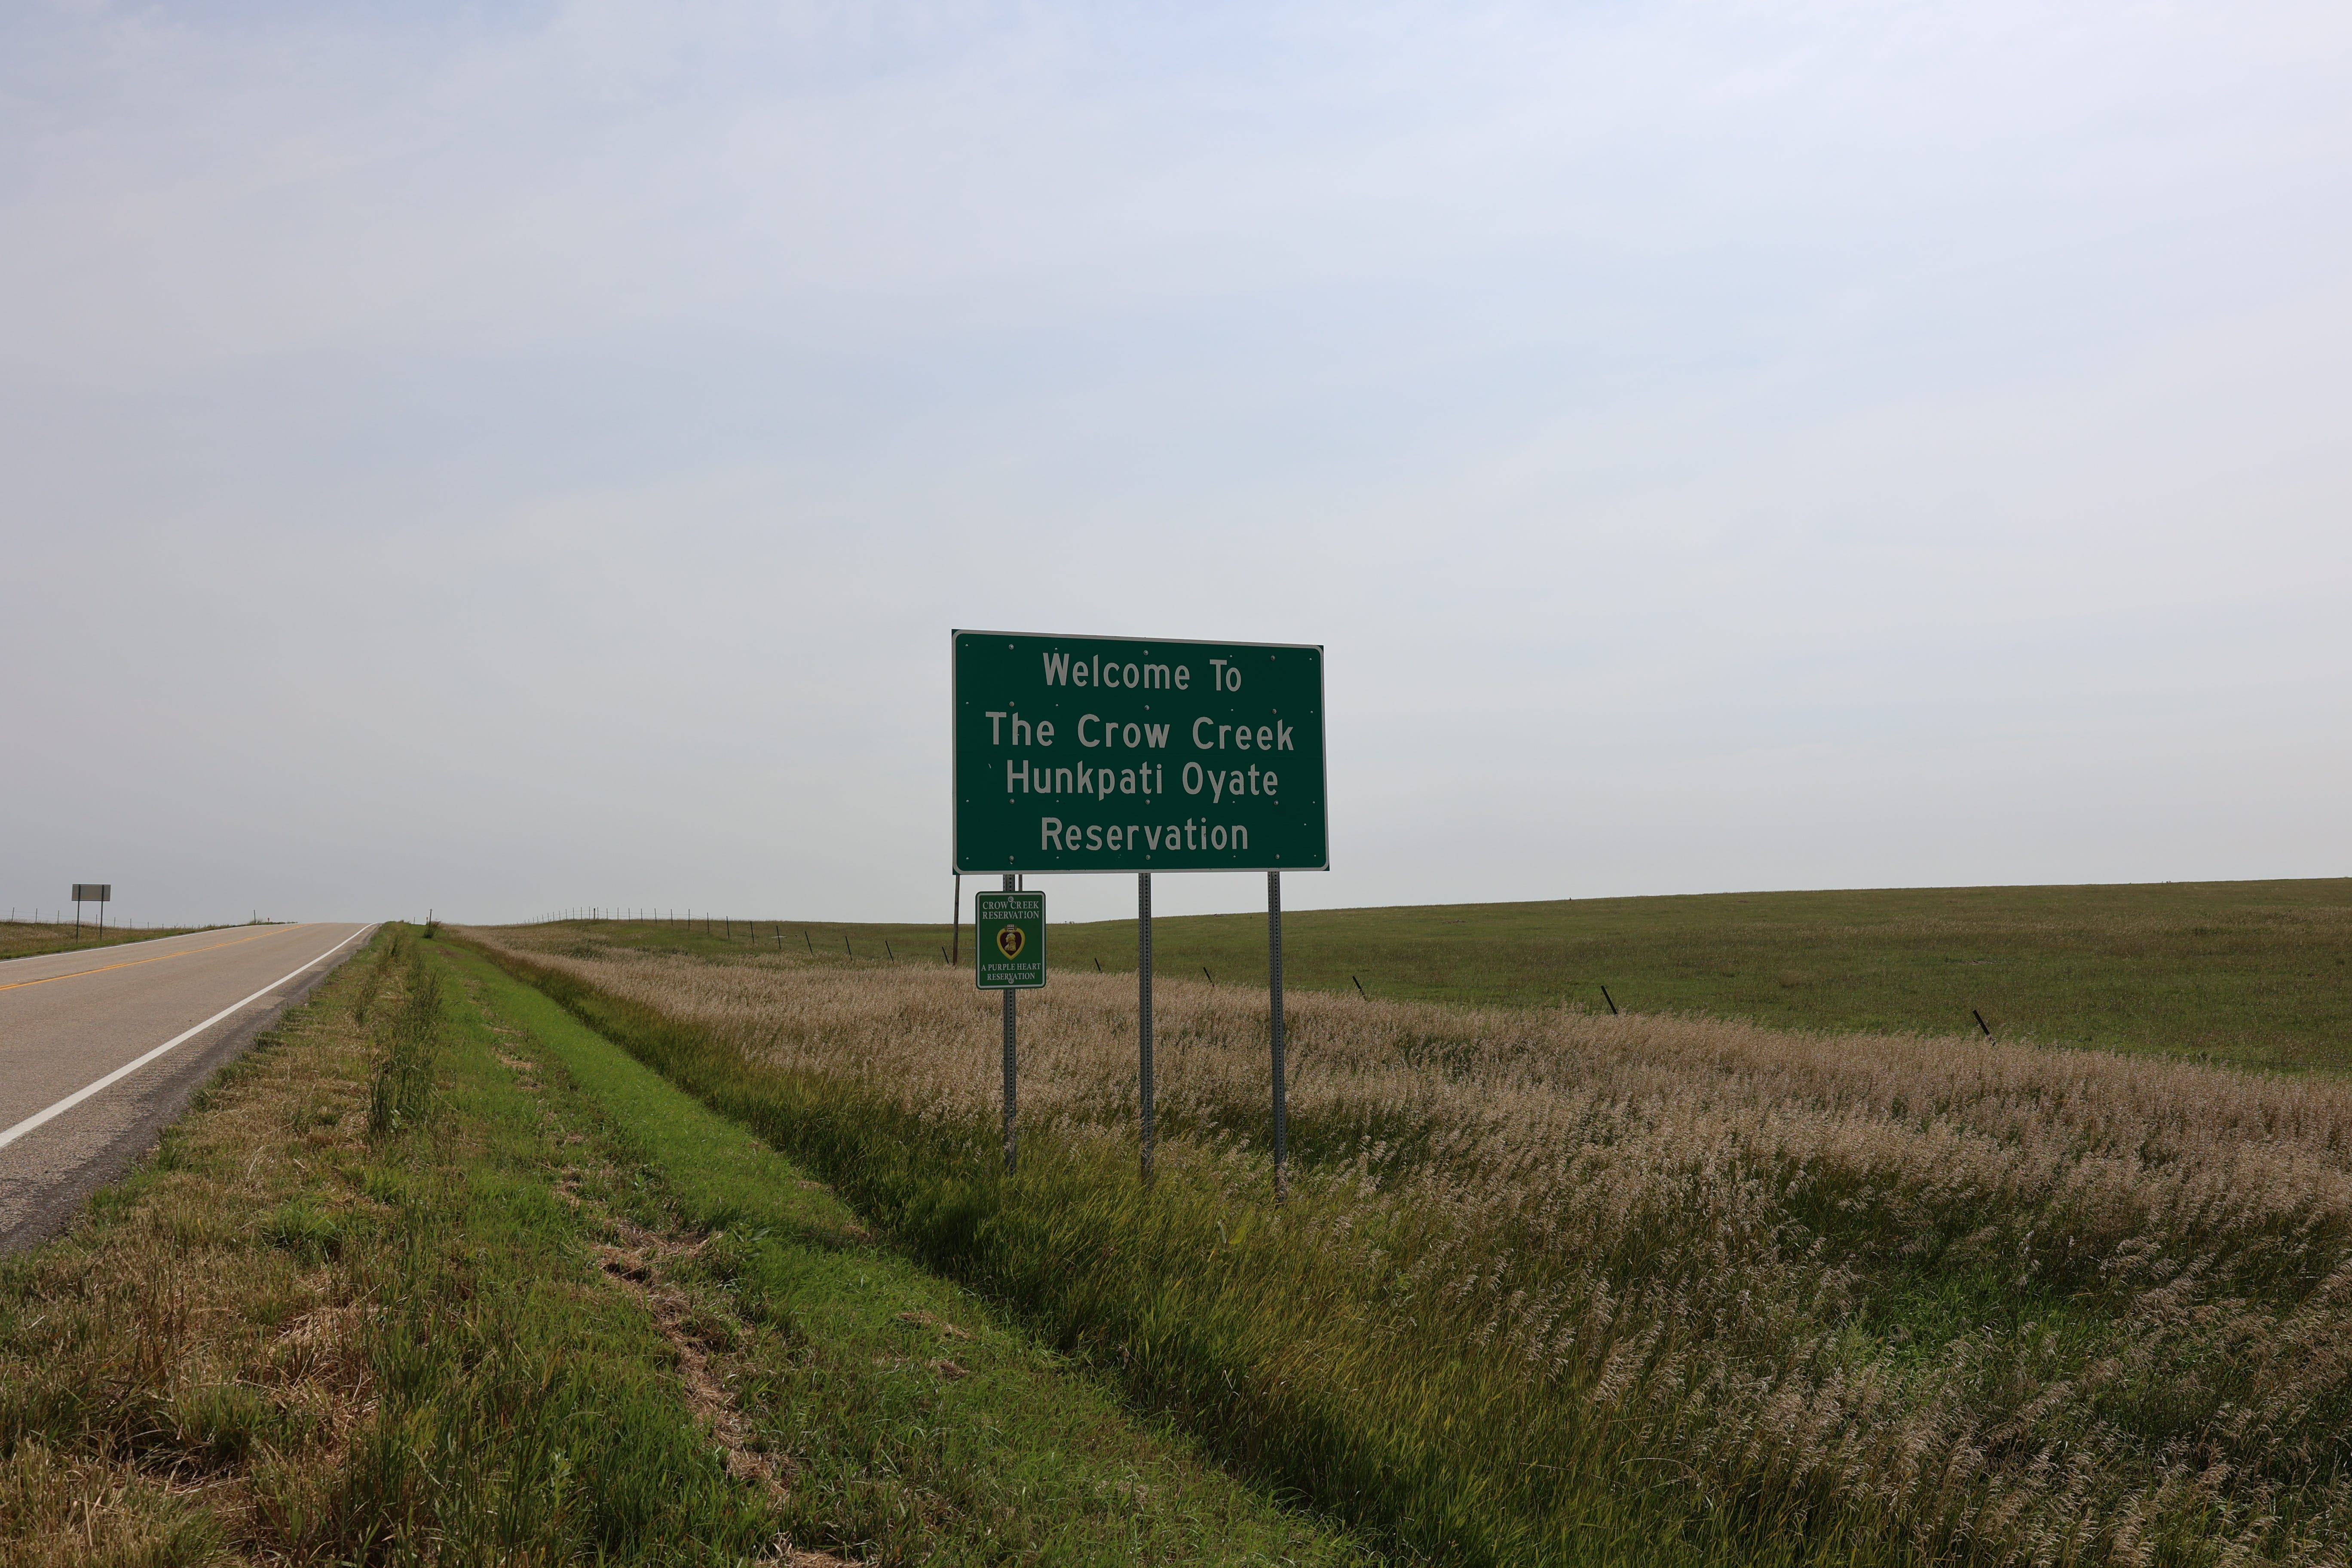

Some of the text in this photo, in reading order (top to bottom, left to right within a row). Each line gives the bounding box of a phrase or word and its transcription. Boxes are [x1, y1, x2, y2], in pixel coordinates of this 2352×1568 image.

[1043, 652, 1241, 692] Welcome To
[985, 711, 1294, 750] The Crow Creek
[1007, 760, 1278, 803] Hunkpati Oyate
[1041, 817, 1248, 850] Reservation
[983, 901, 1039, 910] CROW CREEK
[983, 911, 1039, 919] RESERVATION
